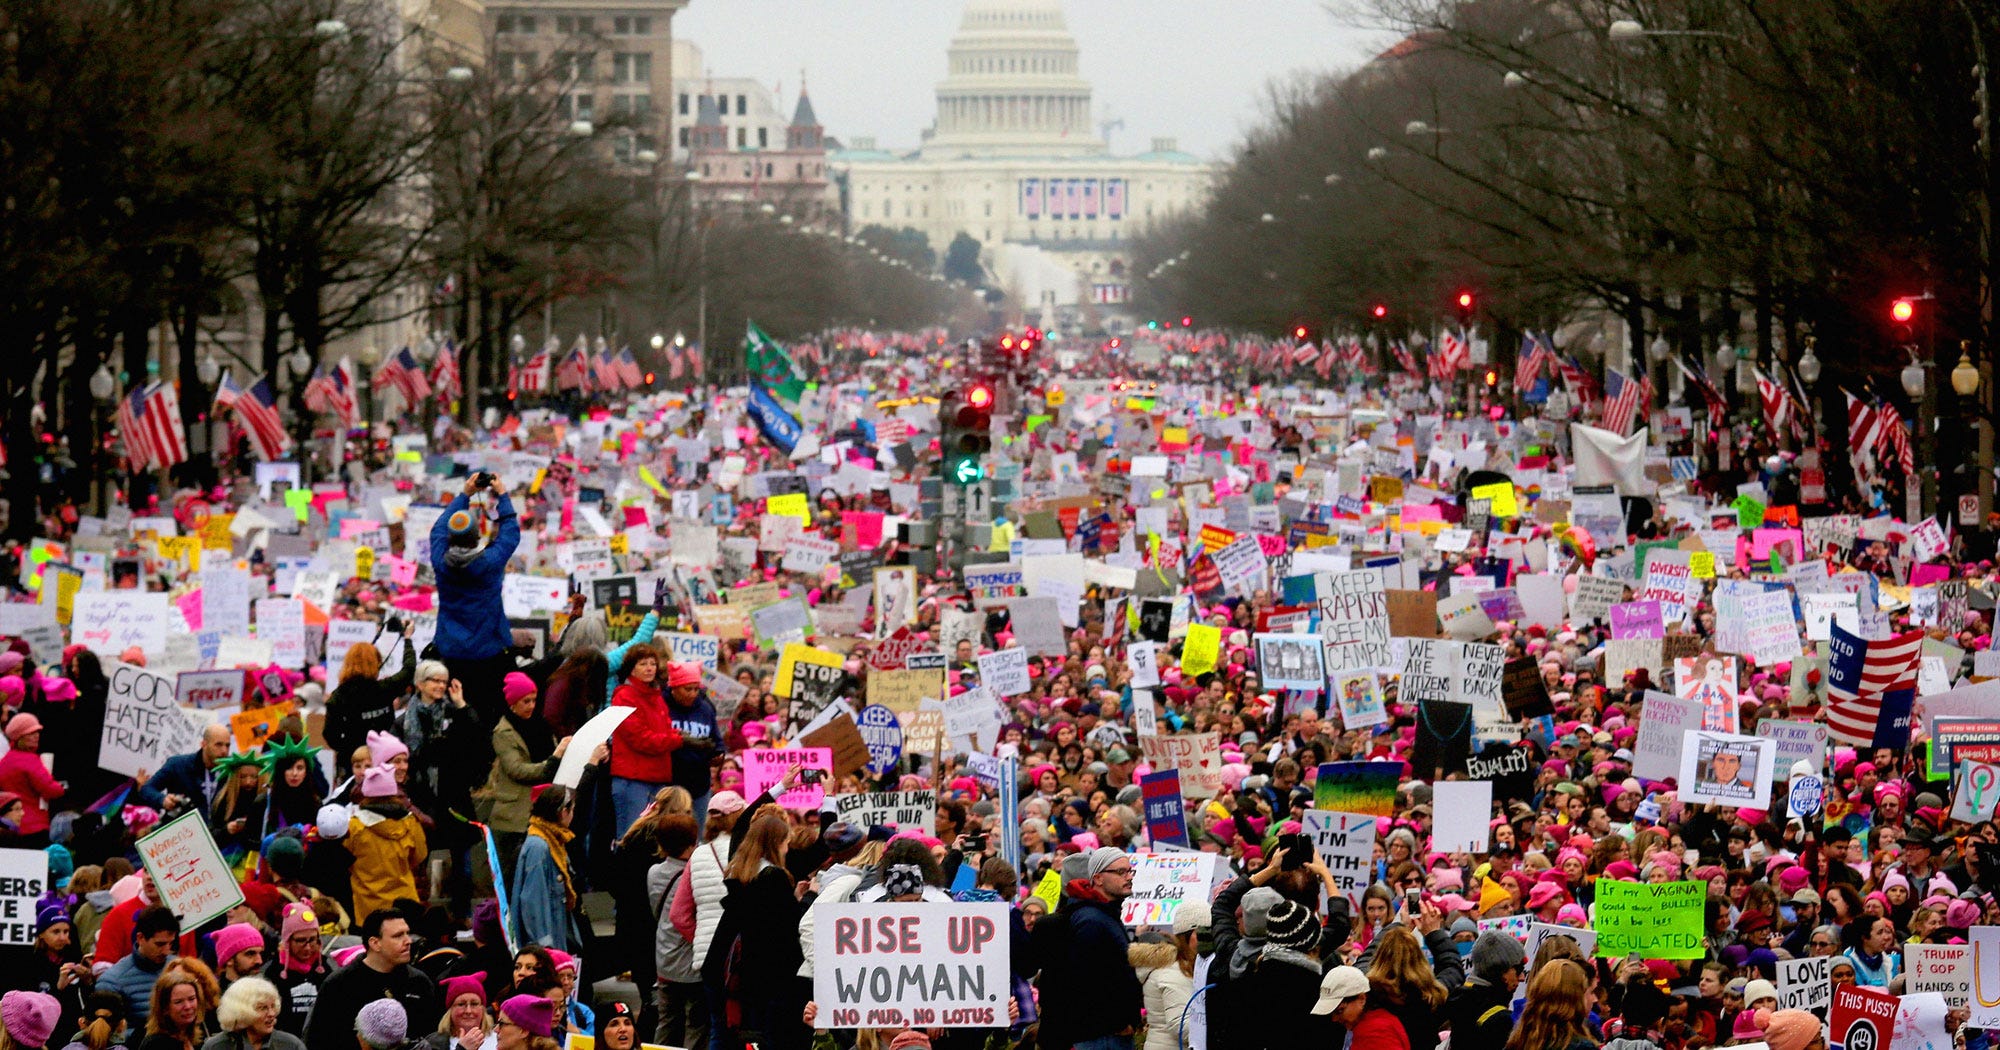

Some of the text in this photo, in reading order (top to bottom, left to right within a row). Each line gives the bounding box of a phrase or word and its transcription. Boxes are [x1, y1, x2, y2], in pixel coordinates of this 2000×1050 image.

[965, 572, 1022, 588] STRONGER
[1650, 562, 1690, 578] DIVERSITY
[1330, 573, 1375, 595] KEEP
[1649, 575, 1685, 590] MAKES
[1319, 592, 1387, 621] RAPISTS
[1644, 588, 1685, 605] AMERICA
[1327, 618, 1388, 648] OFF MY
[672, 636, 716, 657] TCHES
[1409, 639, 1435, 660] WE
[1463, 644, 1505, 663] NEVER
[1830, 633, 1854, 657] ITED
[1328, 644, 1393, 671] CAMPUS
[1405, 660, 1432, 675] ARE
[793, 662, 843, 684] STOP
[113, 667, 174, 710] GOD
[1404, 675, 1450, 692] CITIZENS
[1464, 679, 1499, 701] BACK
[1402, 689, 1446, 701] UNITED
[863, 706, 892, 726] KEEP
[105, 724, 160, 759] TRUM
[1772, 726, 1785, 738] MY
[1142, 735, 1217, 757] UNITED WE
[755, 751, 819, 764] WOMENS
[1466, 746, 1528, 779] EQUALITY
[836, 794, 867, 815] KEEP
[868, 792, 899, 809] YOUR
[863, 809, 922, 826] OFF OUR
[1318, 831, 1347, 848] I'M
[1322, 855, 1360, 871] ITH
[0, 877, 42, 897] ERS
[167, 869, 213, 900] Human
[1332, 876, 1355, 891] ER
[1649, 885, 1698, 898] VAGINA
[1661, 899, 1702, 910] BULLETS
[1630, 915, 1643, 926] be
[835, 916, 996, 955] RISE UP
[1596, 932, 1698, 950] REGULATED
[1923, 949, 1964, 961] TRUMP
[1786, 959, 1828, 986] LOVE
[1929, 963, 1956, 975] GOP
[835, 963, 997, 1003] WOMAN.
[1808, 982, 1829, 1003] HATE
[1915, 982, 1954, 993] HANDS
[1839, 991, 1897, 1019] THIS PUSSY
[1946, 996, 1969, 1008] MEN
[833, 1007, 995, 1028] NO MUD, NO LOTUS
